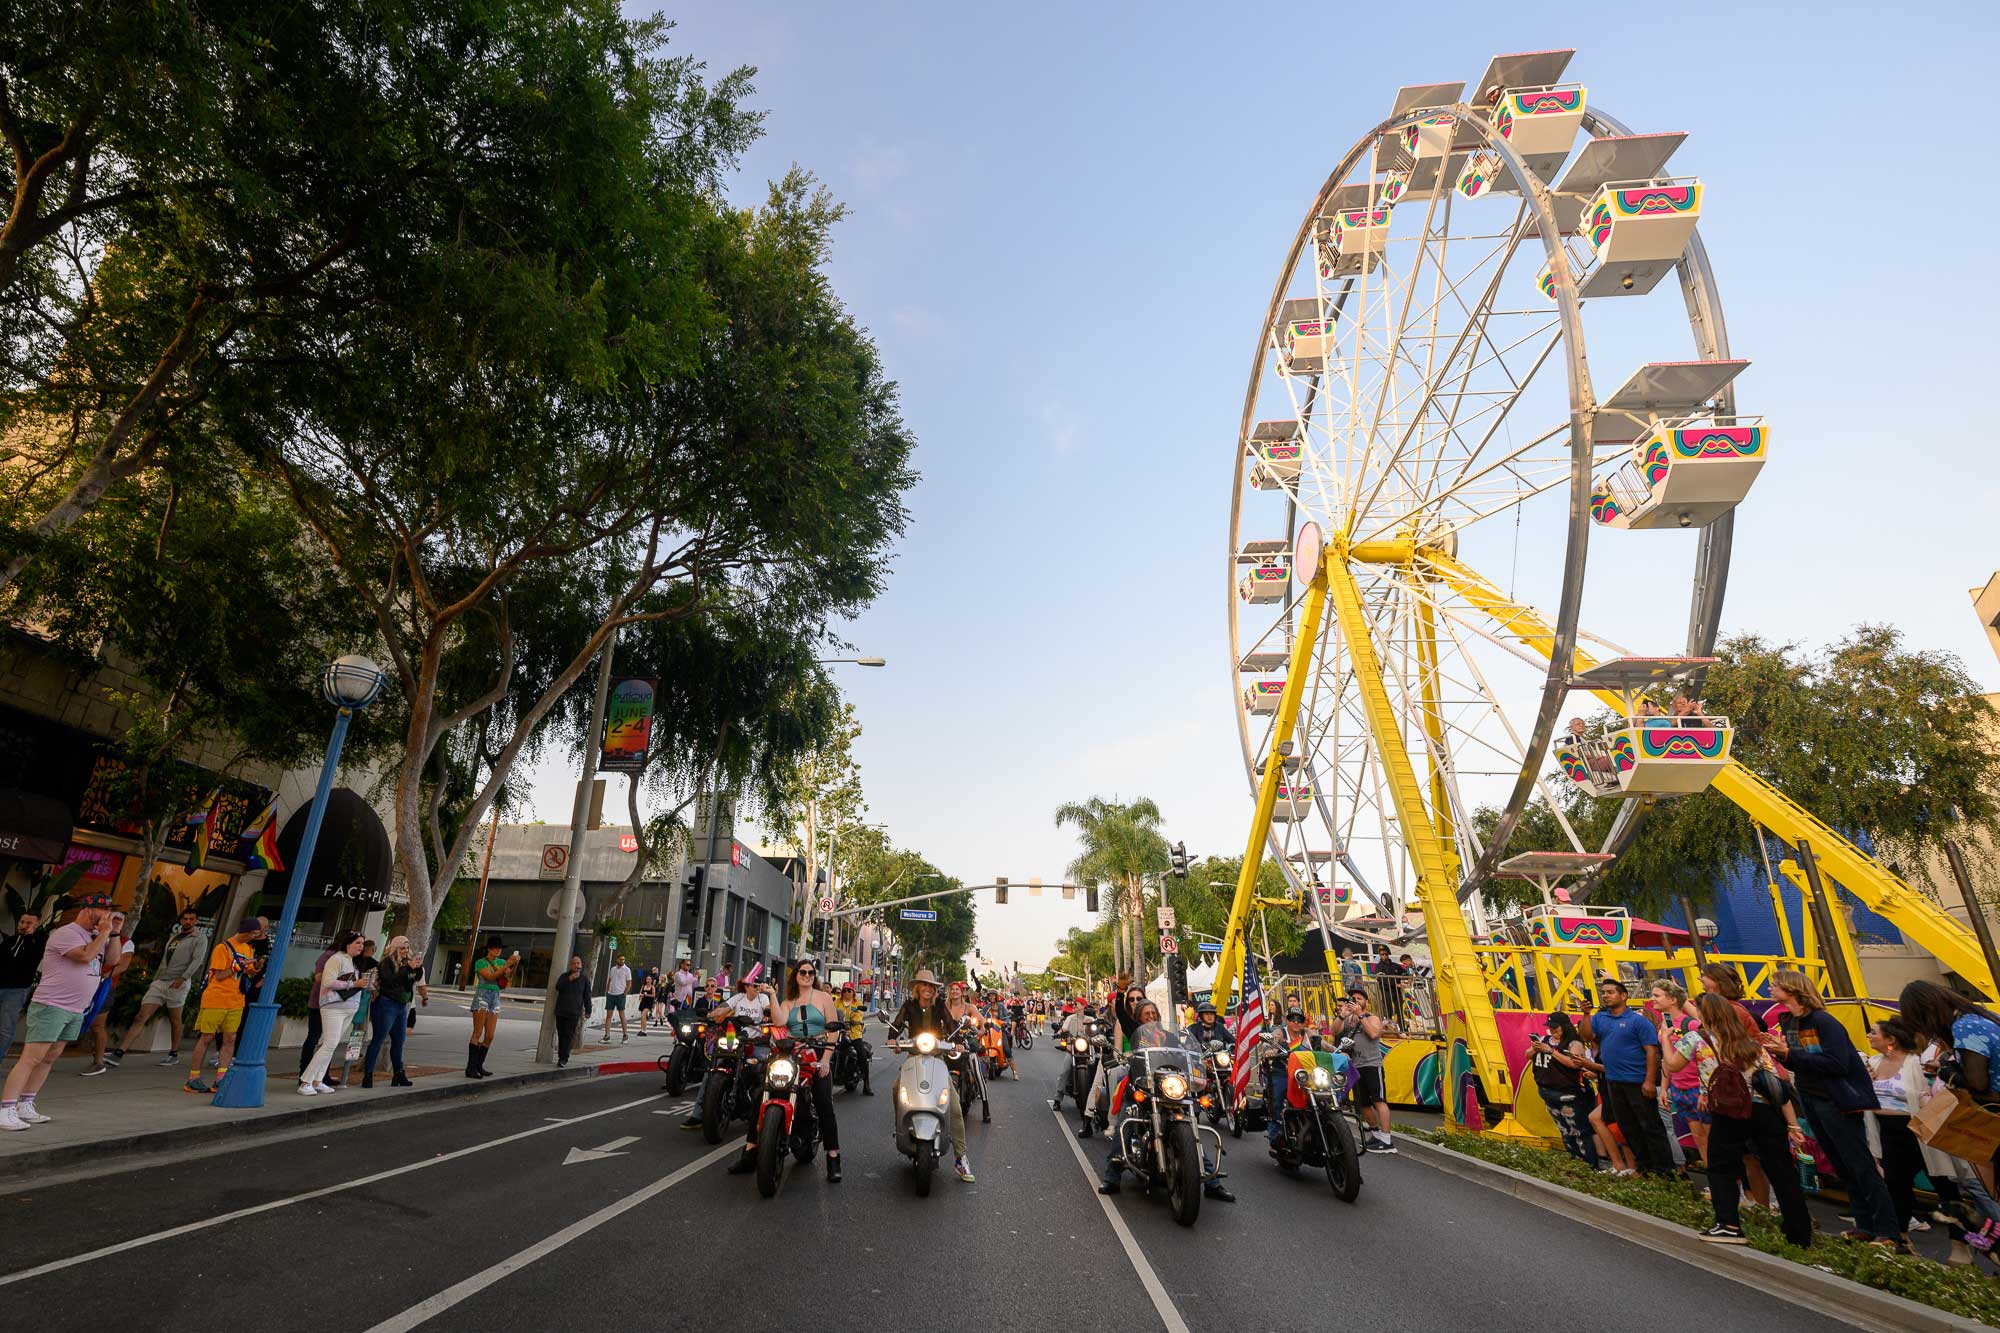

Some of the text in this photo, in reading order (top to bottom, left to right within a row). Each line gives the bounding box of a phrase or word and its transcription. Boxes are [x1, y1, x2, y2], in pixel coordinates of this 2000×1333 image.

[613, 706, 648, 719] JUNE
[611, 718, 646, 734] 2-4
[0, 837, 19, 850] st
[903, 911, 926, 919] Westbourne
[1534, 1052, 1552, 1069] AF
